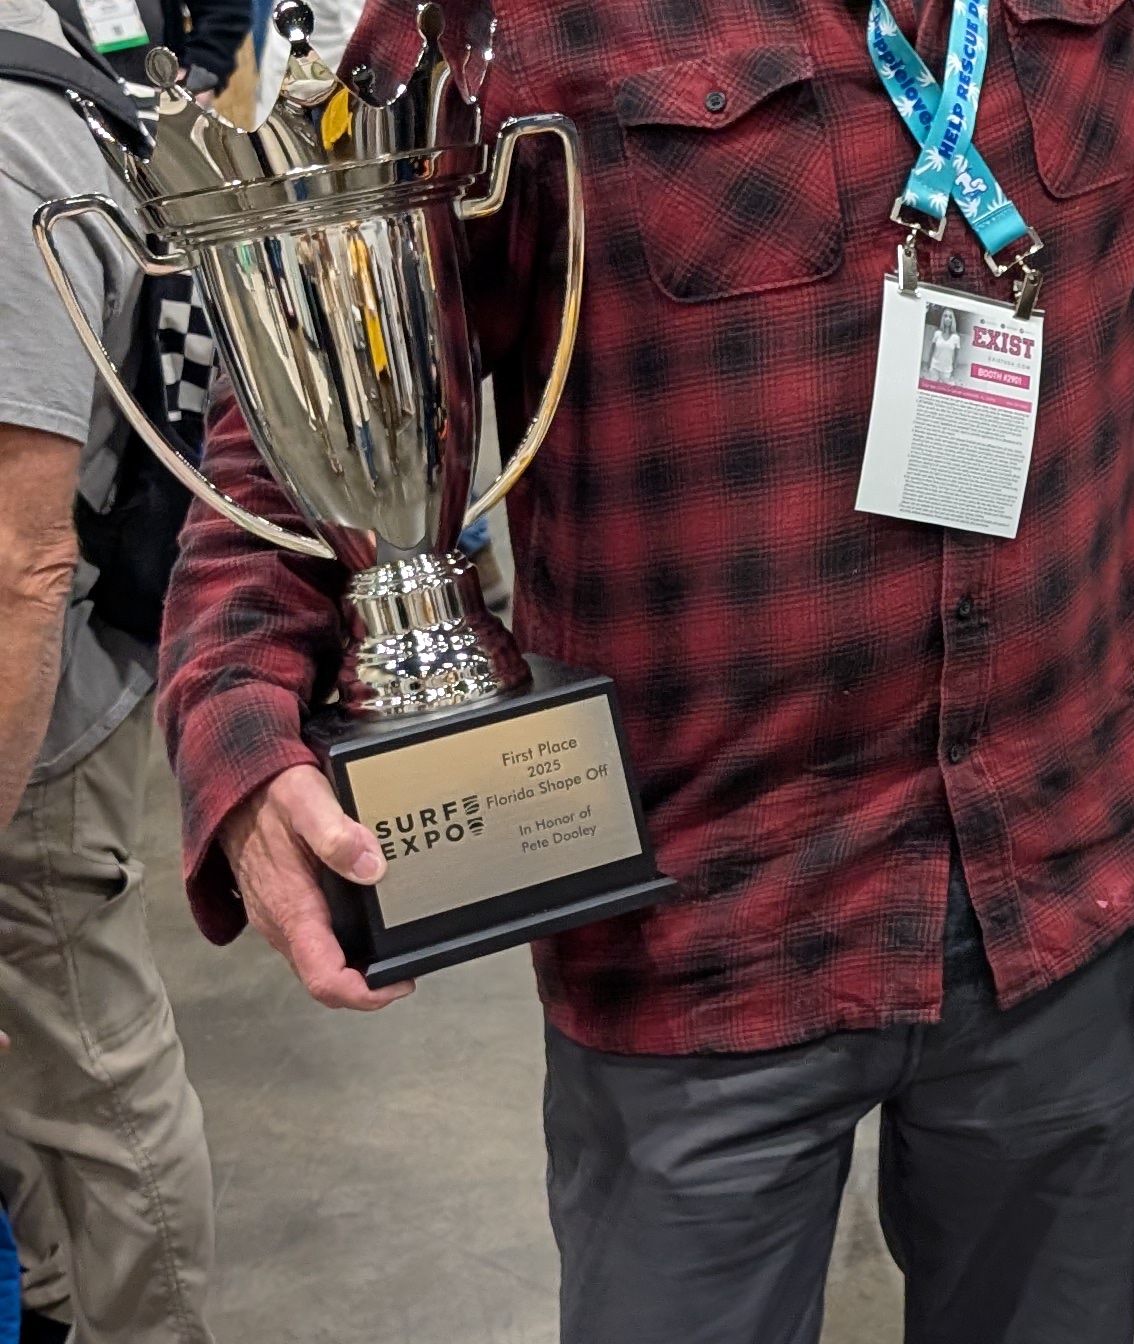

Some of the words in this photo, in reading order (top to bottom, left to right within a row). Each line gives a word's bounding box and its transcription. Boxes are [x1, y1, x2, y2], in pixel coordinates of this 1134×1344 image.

[938, 102, 964, 160] HELP
[957, 18, 979, 101] RESCUE
[972, 325, 1035, 360] EXIST
[977, 367, 1002, 381] BOOTH
[501, 748, 534, 768] First
[537, 737, 578, 758] Place
[527, 759, 562, 779] 2025
[486, 787, 535, 810] Florida
[538, 774, 582, 796] Shape
[586, 763, 609, 781] Off
[375, 800, 459, 840] SURF
[519, 824, 532, 837] In
[535, 813, 577, 834] Honor
[579, 805, 593, 820] of
[380, 823, 465, 862] EXPO
[521, 838, 550, 855] Pete
[552, 823, 598, 848] Dooley
